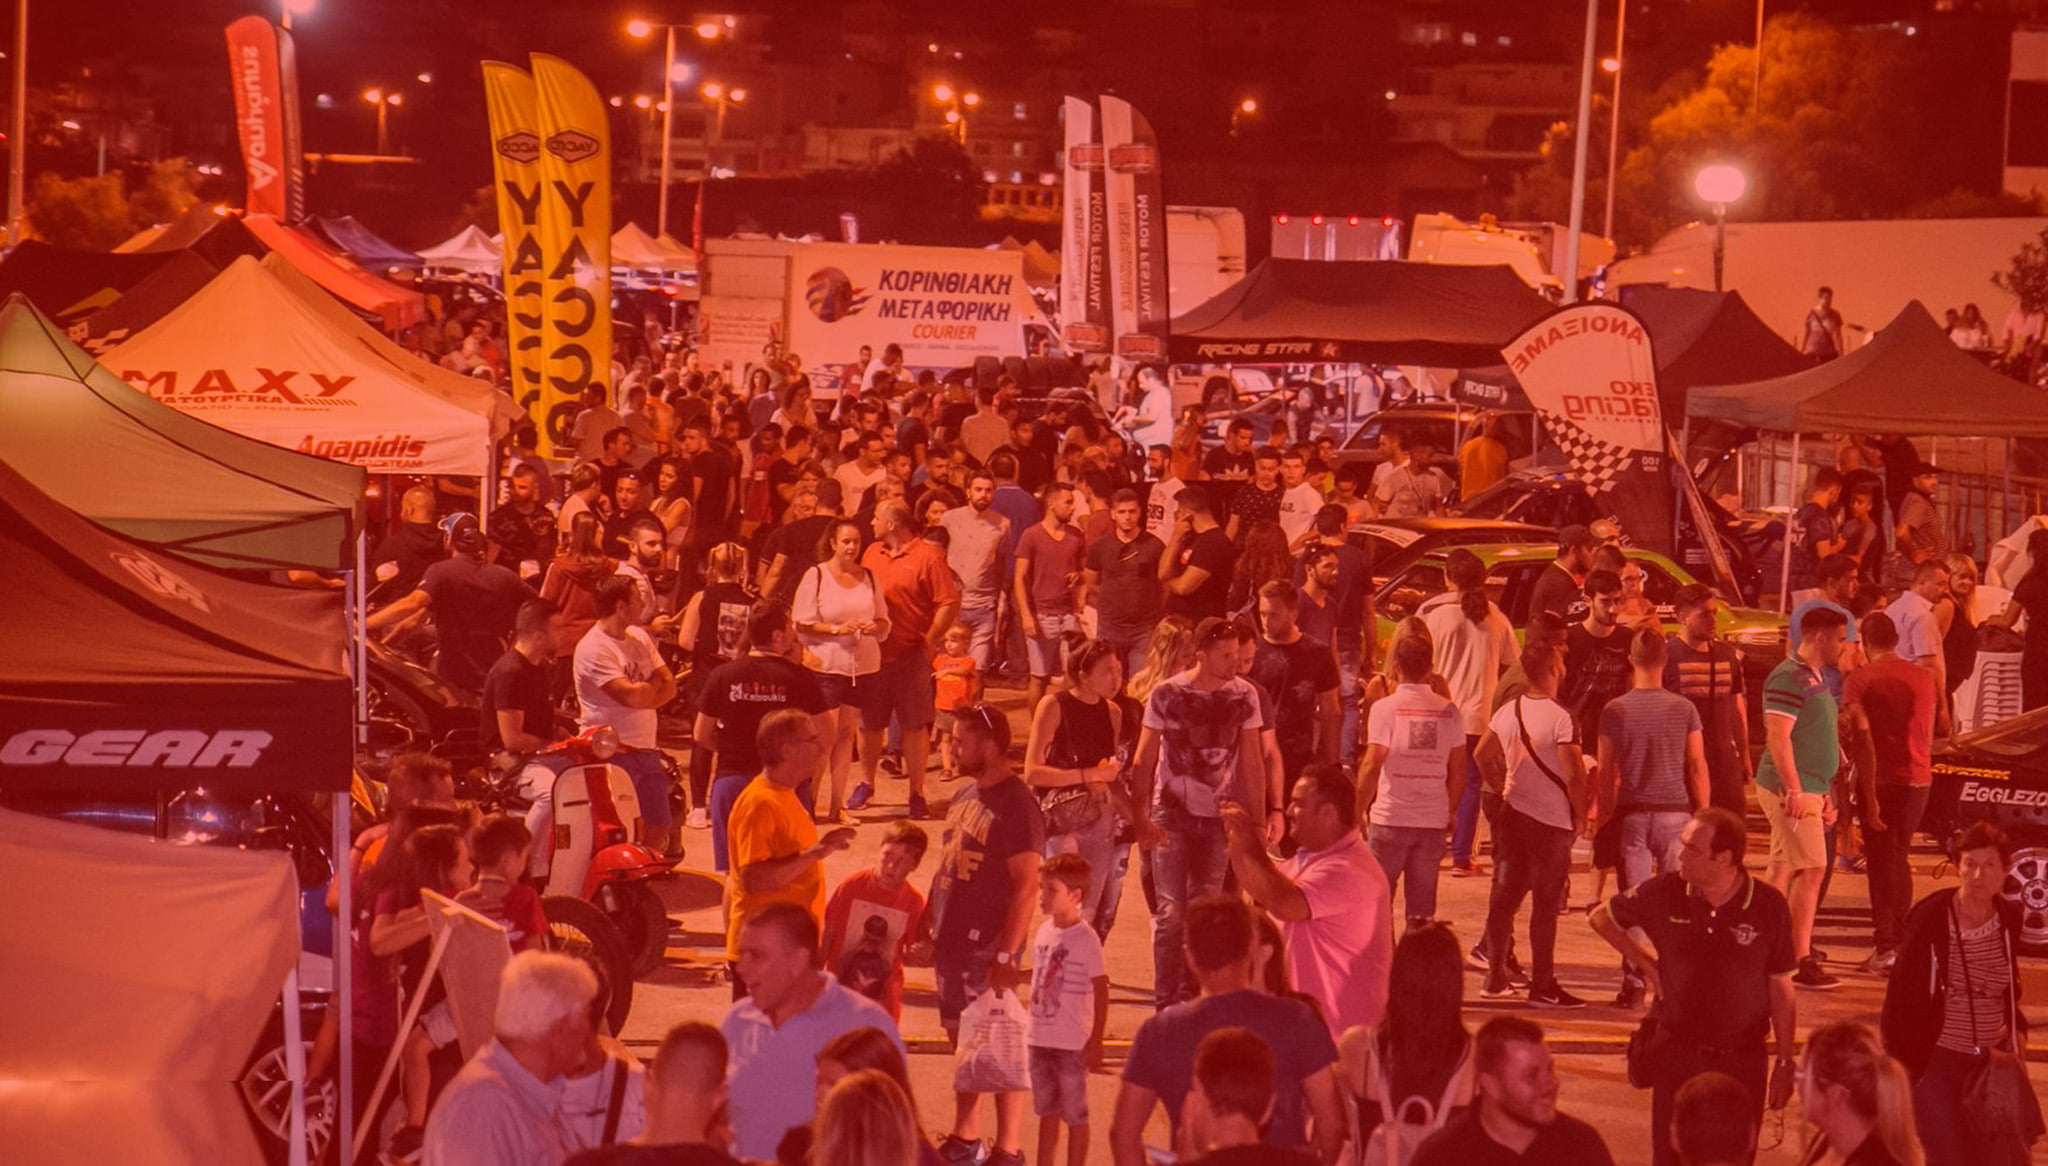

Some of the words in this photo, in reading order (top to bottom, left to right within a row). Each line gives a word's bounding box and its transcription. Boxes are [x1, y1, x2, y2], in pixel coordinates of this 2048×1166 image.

[879, 269, 1013, 295] ΚΟΡΙΝΘΙΑΚΗ
[878, 298, 1011, 321] ΜΕΤΑΦΟΡΙΚΗ
[912, 323, 977, 339] COURIER
[1197, 343, 1260, 357] RACING
[1263, 343, 1312, 354] STAR
[0, 729, 273, 768] GEAR
